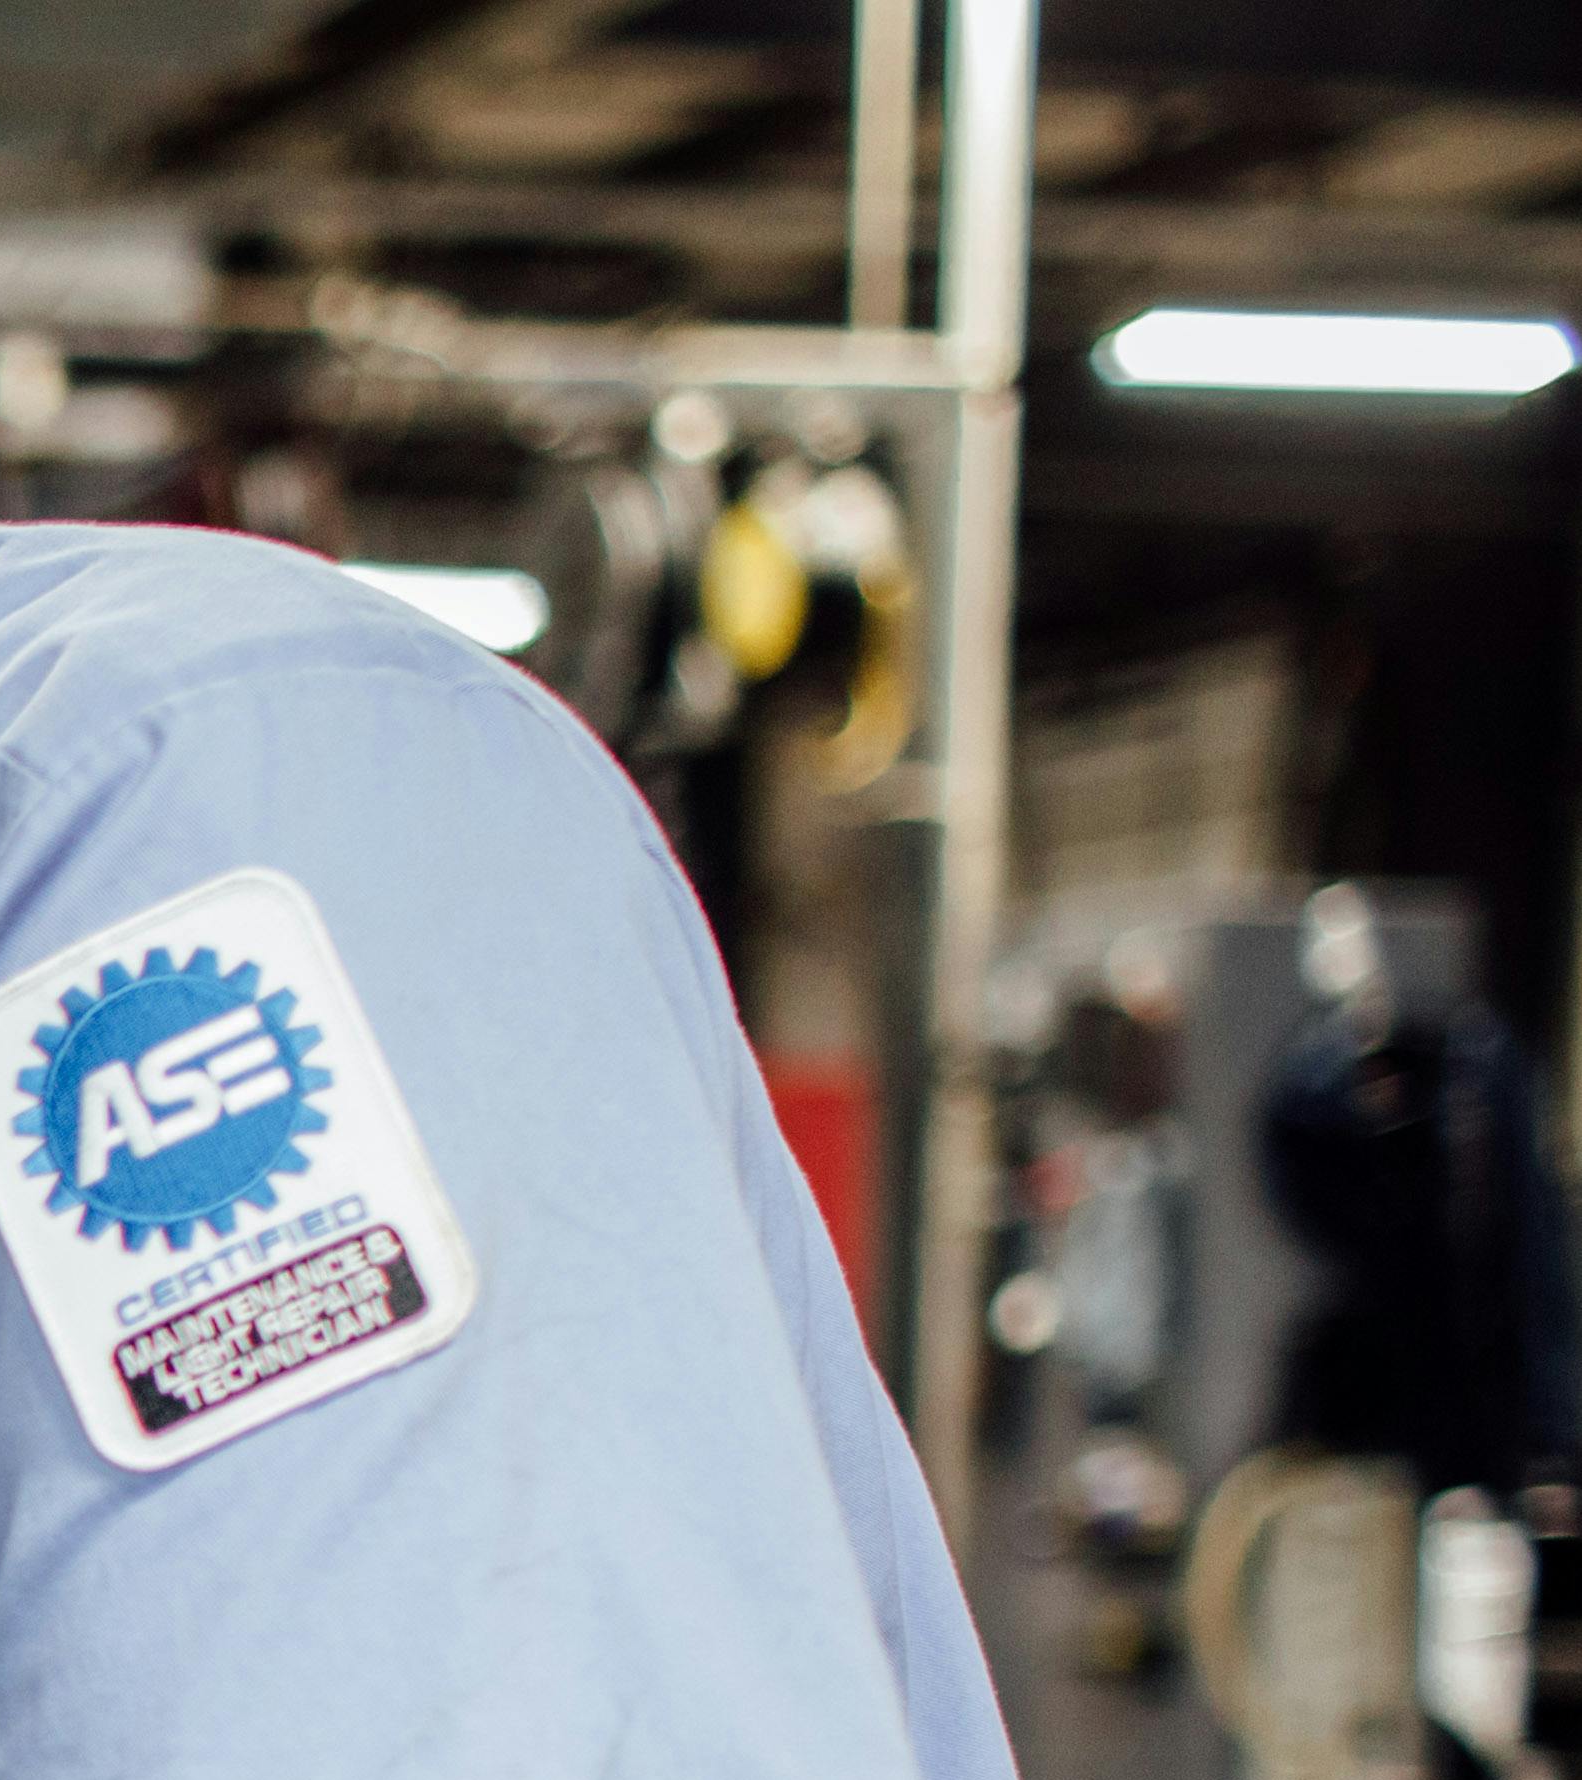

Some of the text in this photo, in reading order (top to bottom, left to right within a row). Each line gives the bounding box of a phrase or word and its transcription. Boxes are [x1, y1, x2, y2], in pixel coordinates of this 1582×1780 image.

[77, 1003, 292, 1188] ASE
[116, 1194, 368, 1327] CERTIFIED
[117, 1228, 403, 1379] MAINTENANCE &
[154, 1266, 390, 1394] LIGHT REPAIR
[172, 1296, 393, 1411] TECHNICIAN
